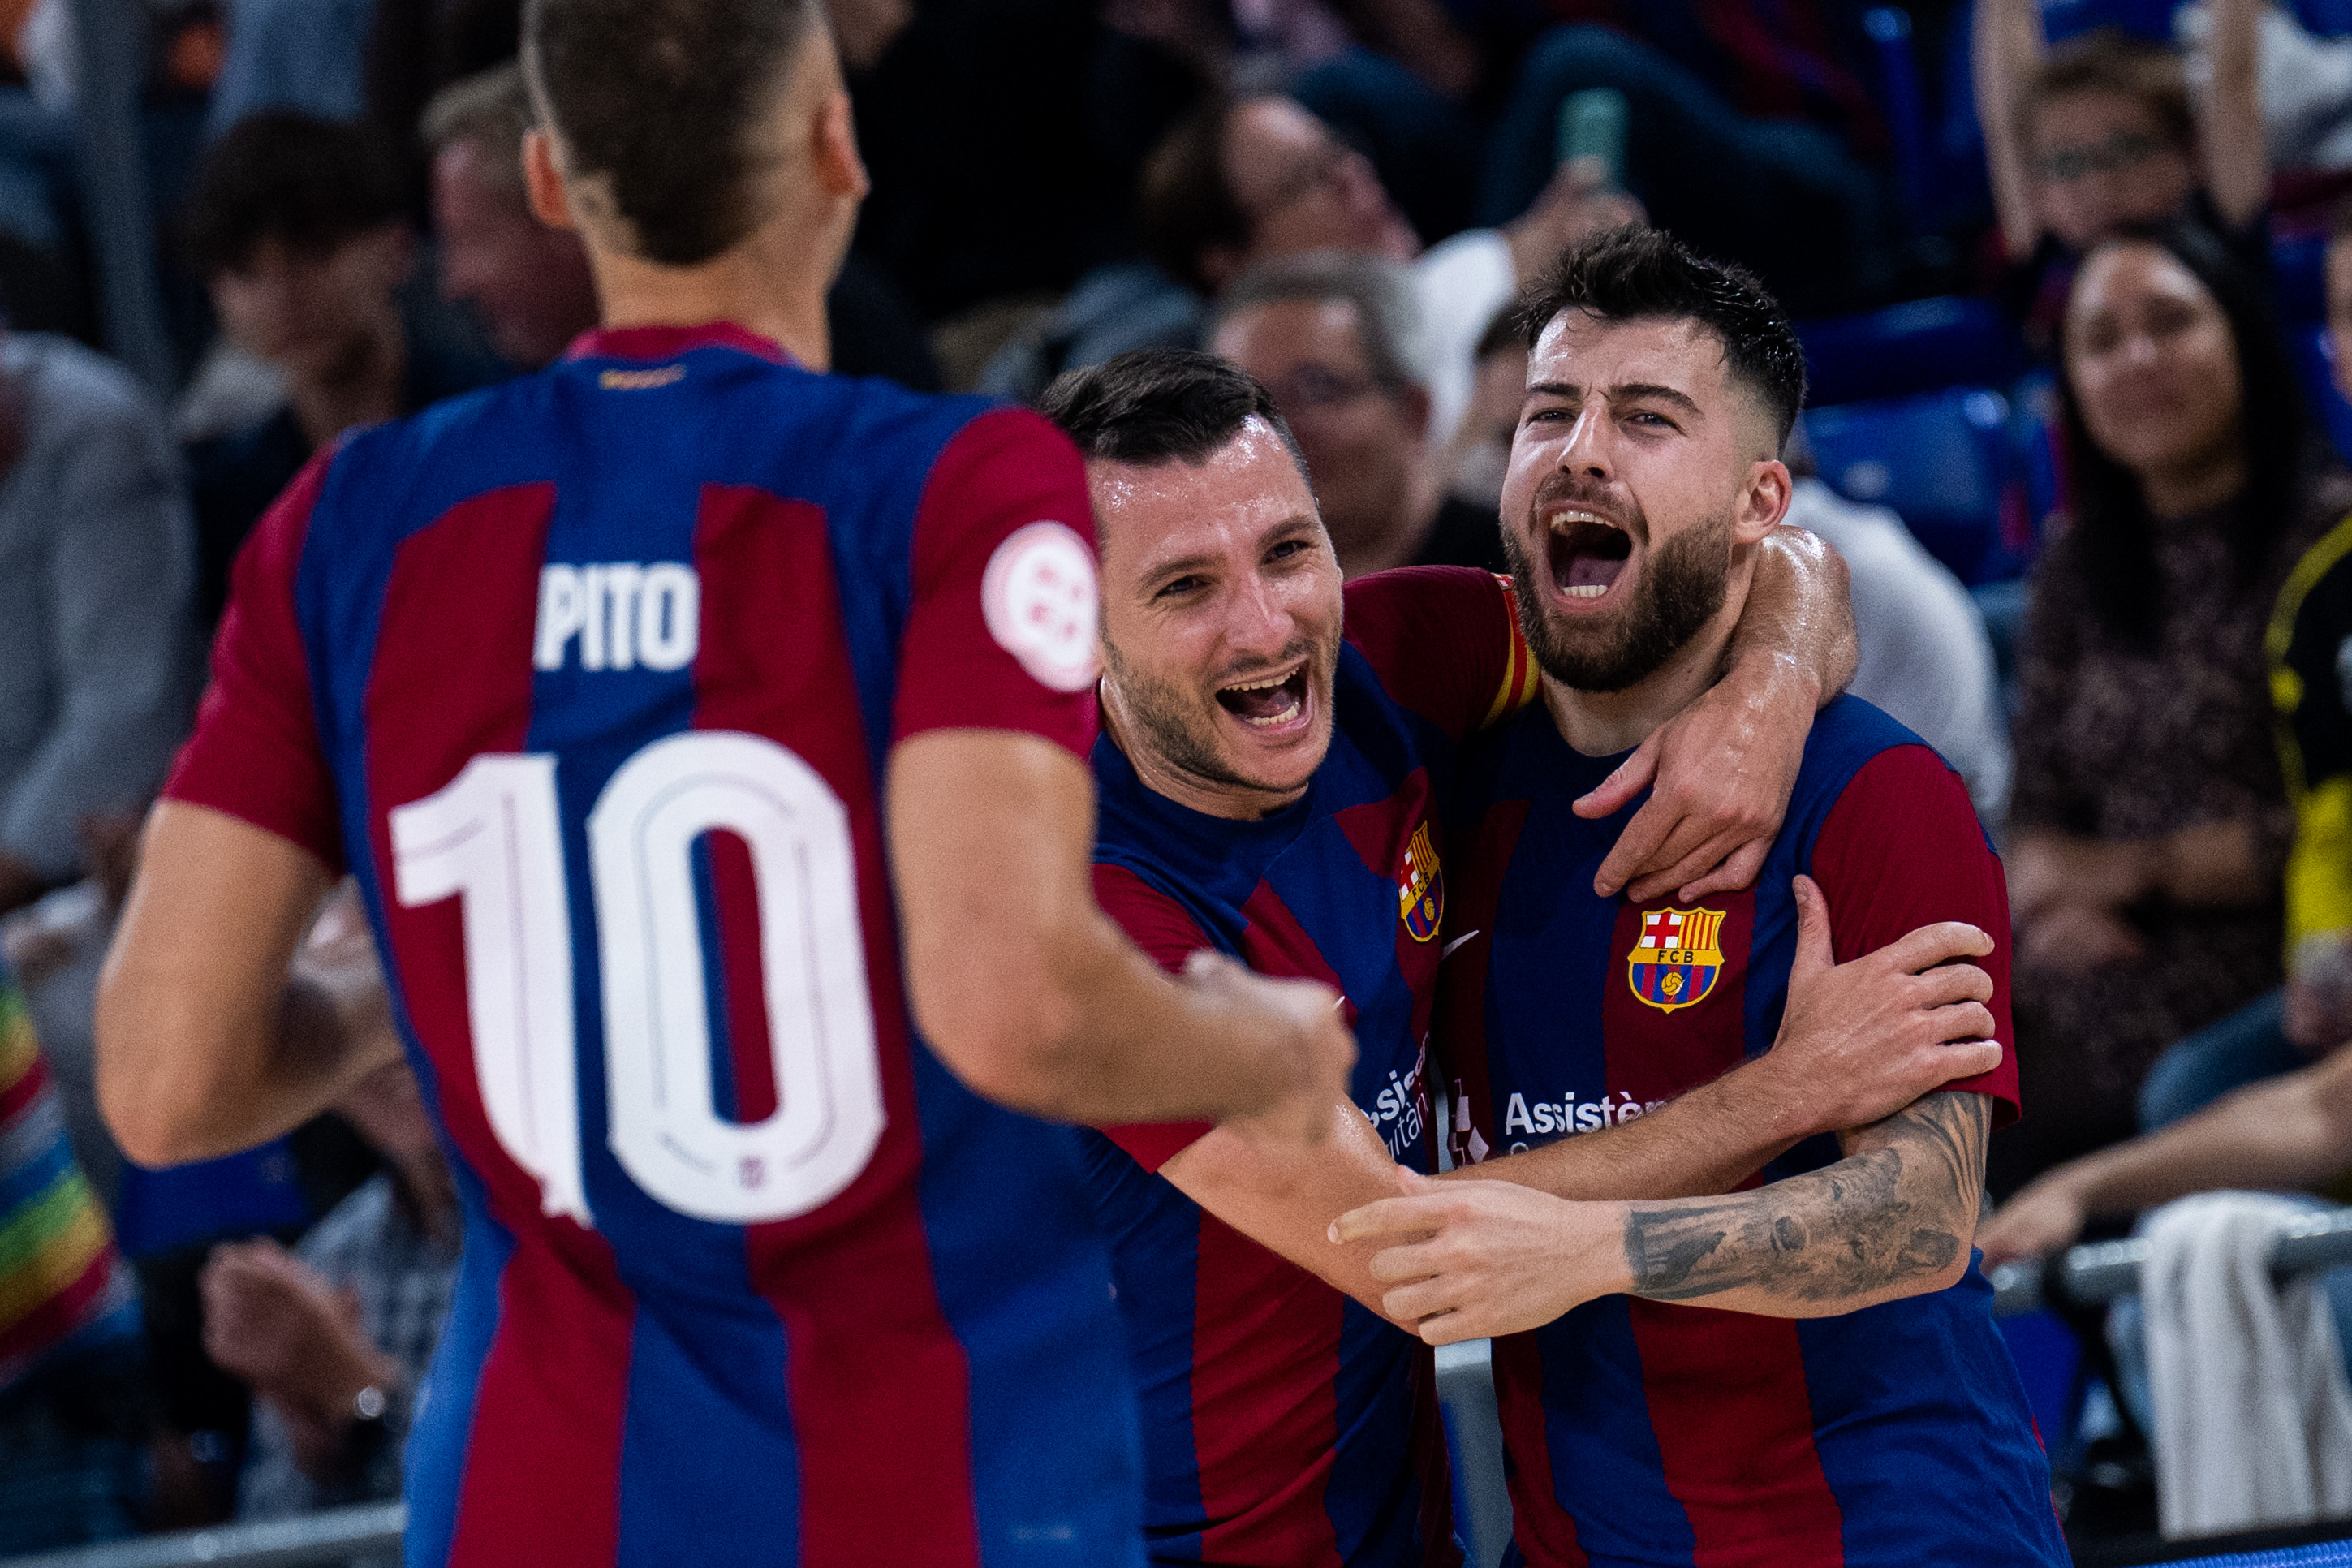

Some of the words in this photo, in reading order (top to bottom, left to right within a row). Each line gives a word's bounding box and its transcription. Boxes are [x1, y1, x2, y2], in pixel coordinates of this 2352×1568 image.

[532, 561, 702, 672] PITO
[389, 729, 888, 1227] 10
[1656, 950, 1695, 964] FCB
